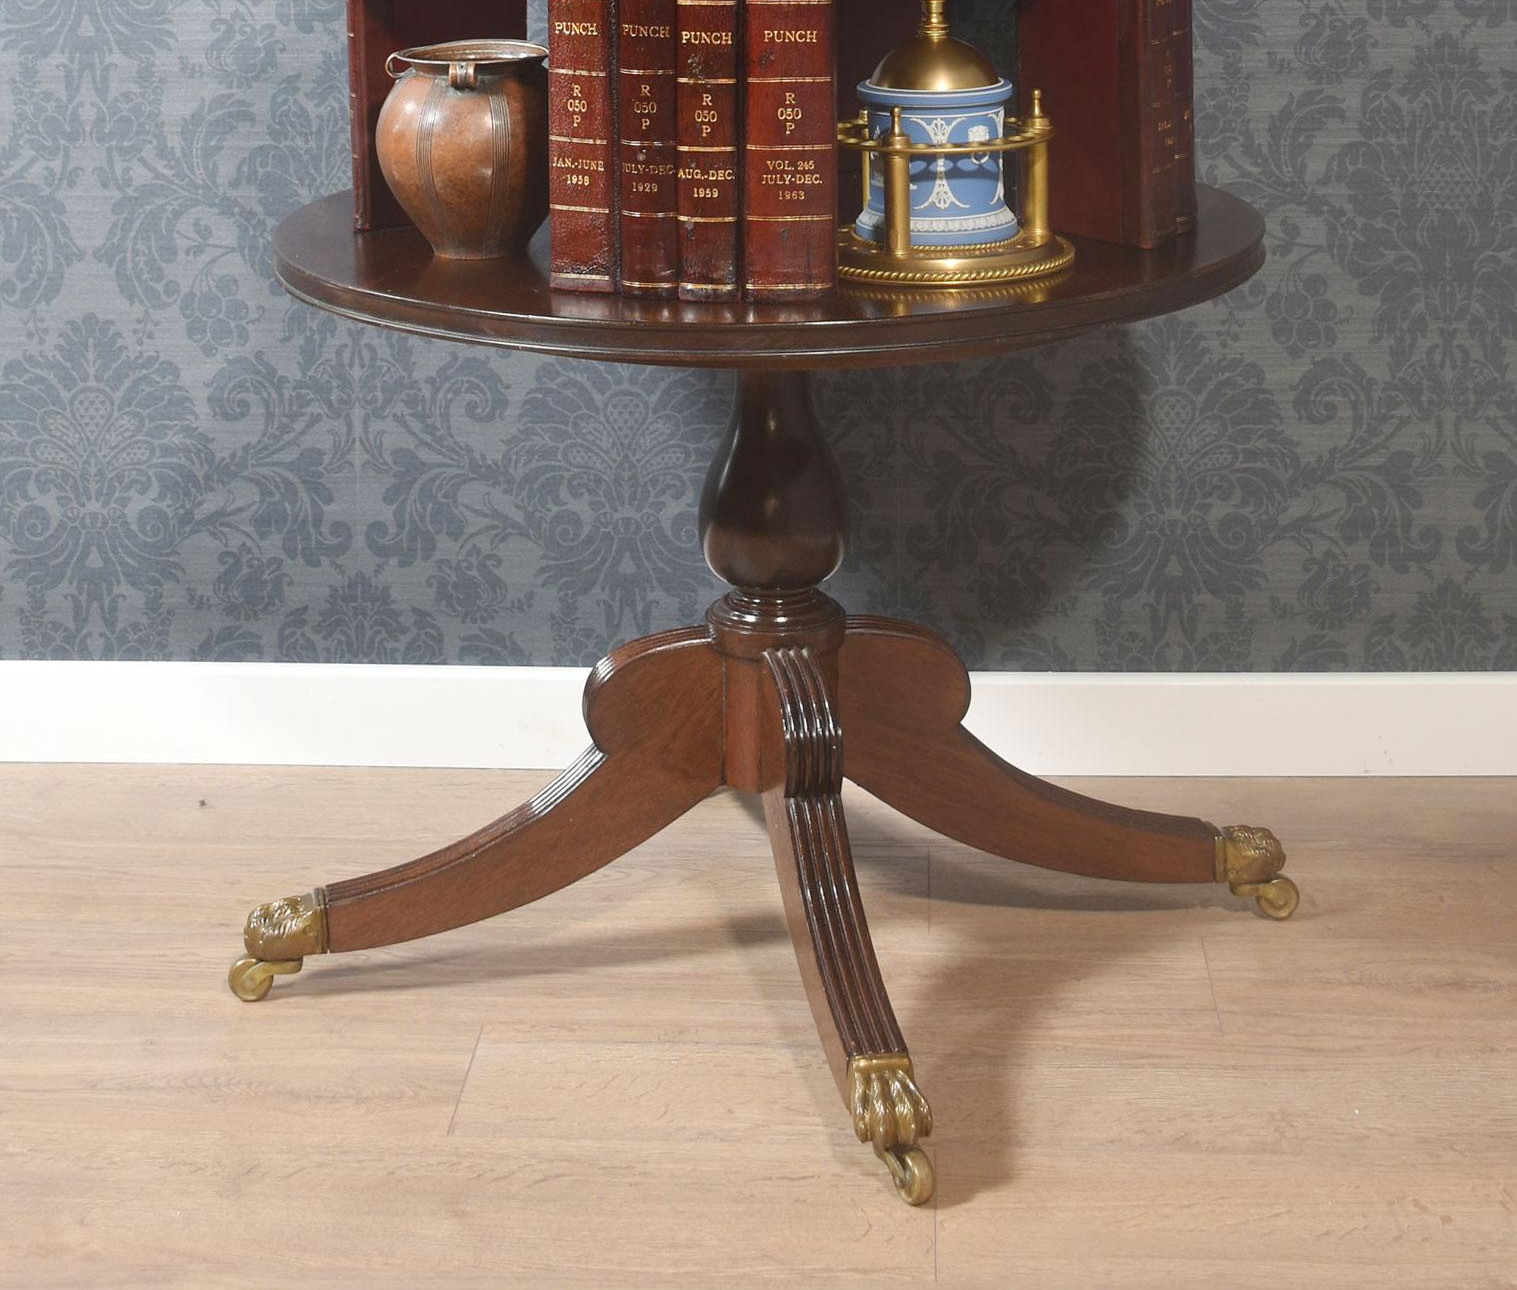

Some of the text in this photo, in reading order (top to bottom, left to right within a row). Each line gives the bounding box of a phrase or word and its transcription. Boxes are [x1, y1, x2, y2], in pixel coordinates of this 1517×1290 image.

[554, 22, 598, 35] PUNCH
[623, 24, 671, 38] PUNCH
[681, 31, 733, 45] PUNCH
[763, 30, 818, 43] PUNCH
[572, 85, 582, 97] R
[640, 85, 651, 96] R
[702, 94, 712, 106] R
[785, 92, 796, 104] R
[567, 100, 588, 112] 050
[633, 101, 657, 114] 050
[694, 110, 718, 122] 050
[777, 108, 802, 120] 050
[573, 115, 581, 127] P
[642, 118, 650, 130] P
[702, 125, 711, 137] P
[785, 122, 796, 135] P
[552, 157, 605, 172] JAN.-JUNE
[766, 160, 795, 170] VOL.
[566, 174, 590, 186] 1958
[677, 168, 736, 181] AUG.-DEC.
[761, 174, 823, 185] JULY-DEC.
[632, 182, 658, 193] 1929
[693, 188, 719, 199] 1959
[778, 190, 805, 201] 1963
